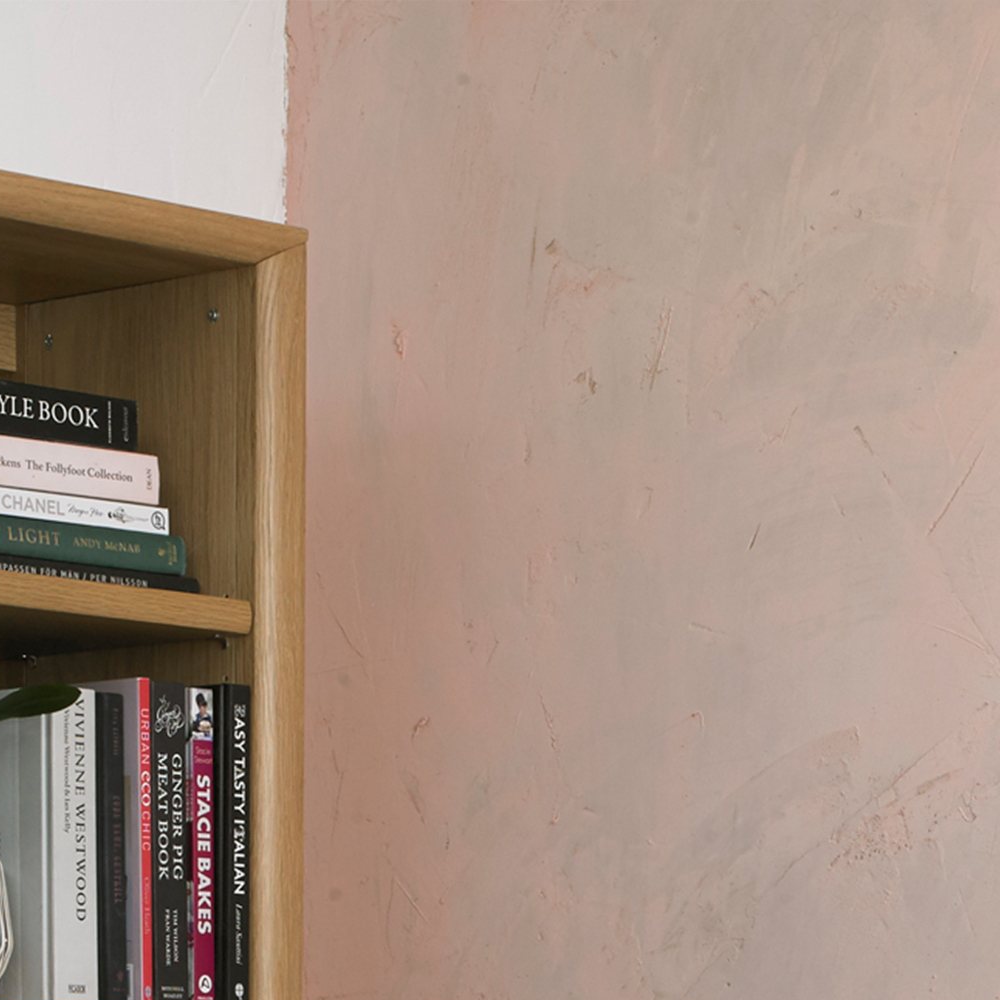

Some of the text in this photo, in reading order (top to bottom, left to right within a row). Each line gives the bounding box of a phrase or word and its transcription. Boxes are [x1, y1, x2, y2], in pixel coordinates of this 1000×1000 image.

[39, 402, 100, 430] BOOK
[25, 459, 133, 482] The Follyfoot Collection
[1, 494, 65, 516] CHANEL
[7, 527, 61, 546] LIGHT
[72, 536, 141, 554] ANDY McNAB
[90, 573, 107, 584] PER
[110, 576, 149, 588] NILSSON
[141, 708, 150, 765] URBAN
[74, 699, 87, 922] VIVIENNE WESTWOOD
[196, 774, 211, 851] STACIE
[233, 757, 246, 815] TASTY
[142, 811, 151, 851] CHIC
[157, 752, 170, 881] MEAT BOOK
[172, 753, 184, 881] GINGER PIG
[233, 819, 246, 895] ITALIAN
[196, 857, 211, 935] BAKES
